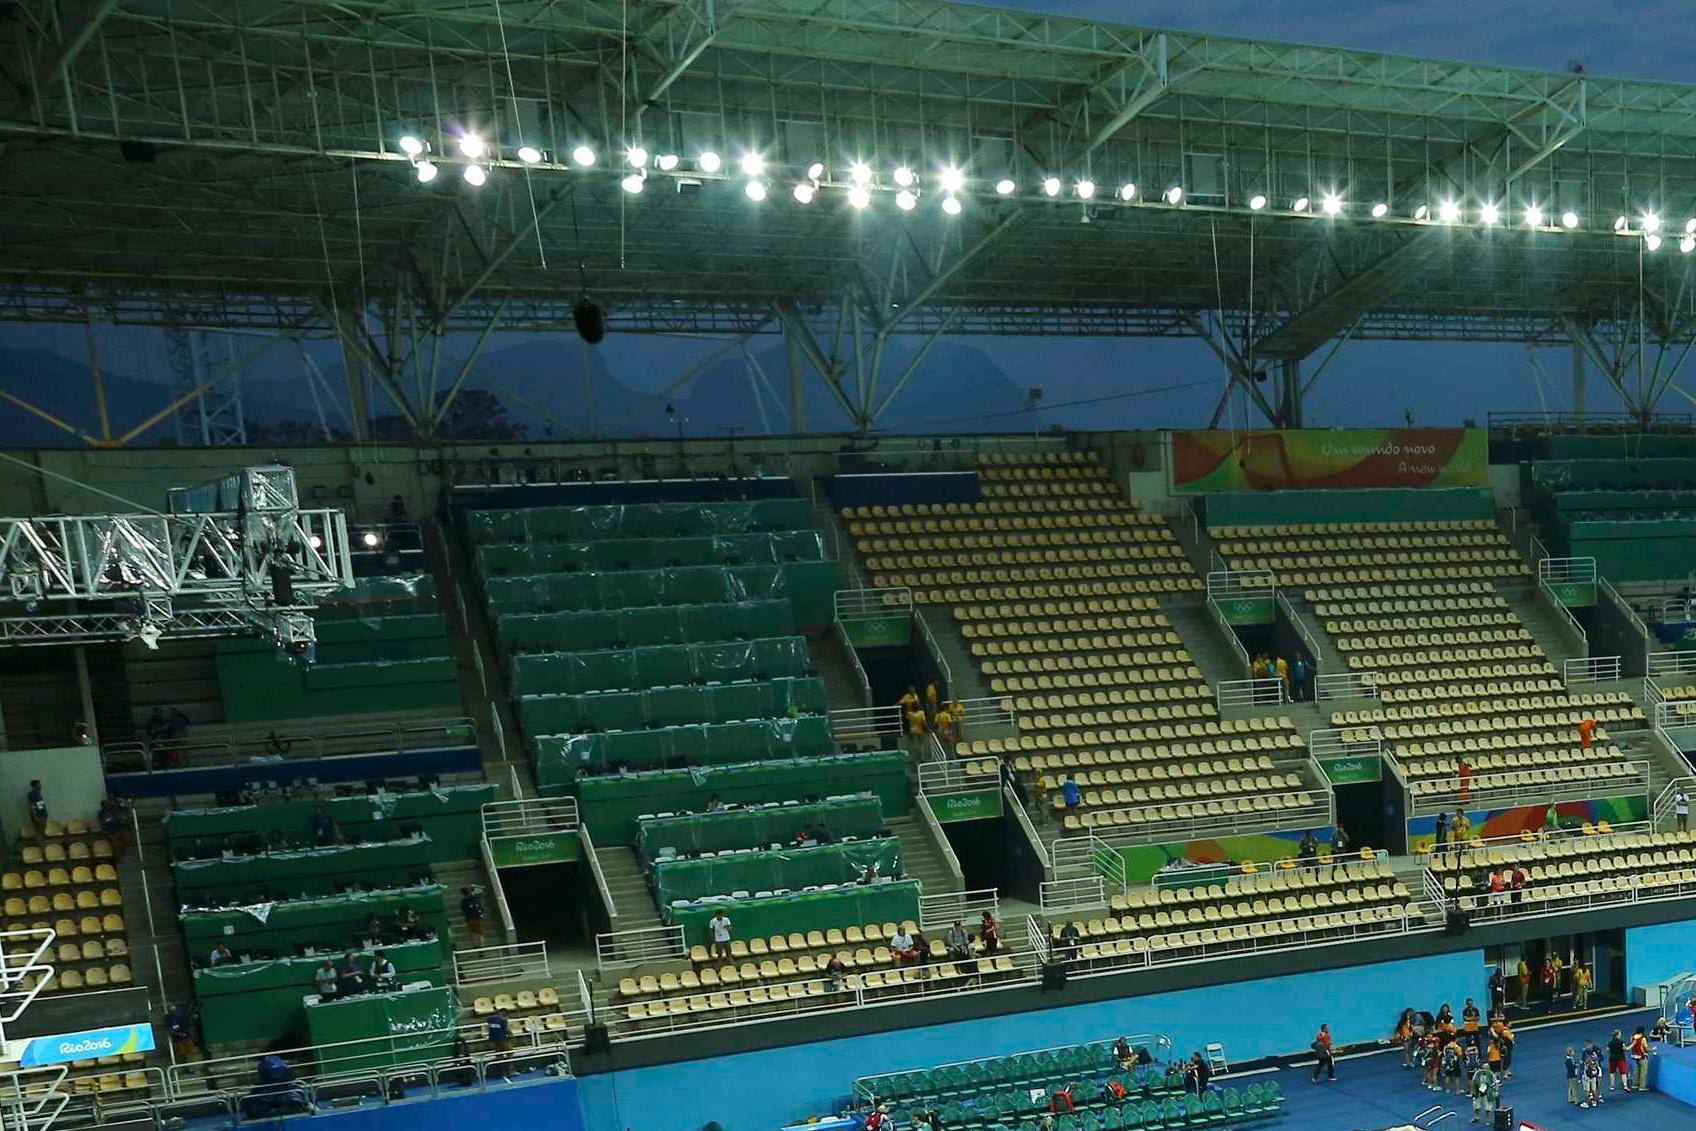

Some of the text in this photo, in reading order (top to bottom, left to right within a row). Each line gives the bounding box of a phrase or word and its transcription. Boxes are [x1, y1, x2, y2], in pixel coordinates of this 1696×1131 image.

[1351, 441, 1400, 456] mundo
[1403, 445, 1436, 455] novo
[947, 796, 981, 809] Rio2016
[515, 840, 556, 852] Rio2016
[59, 1037, 112, 1054] Rio2016
